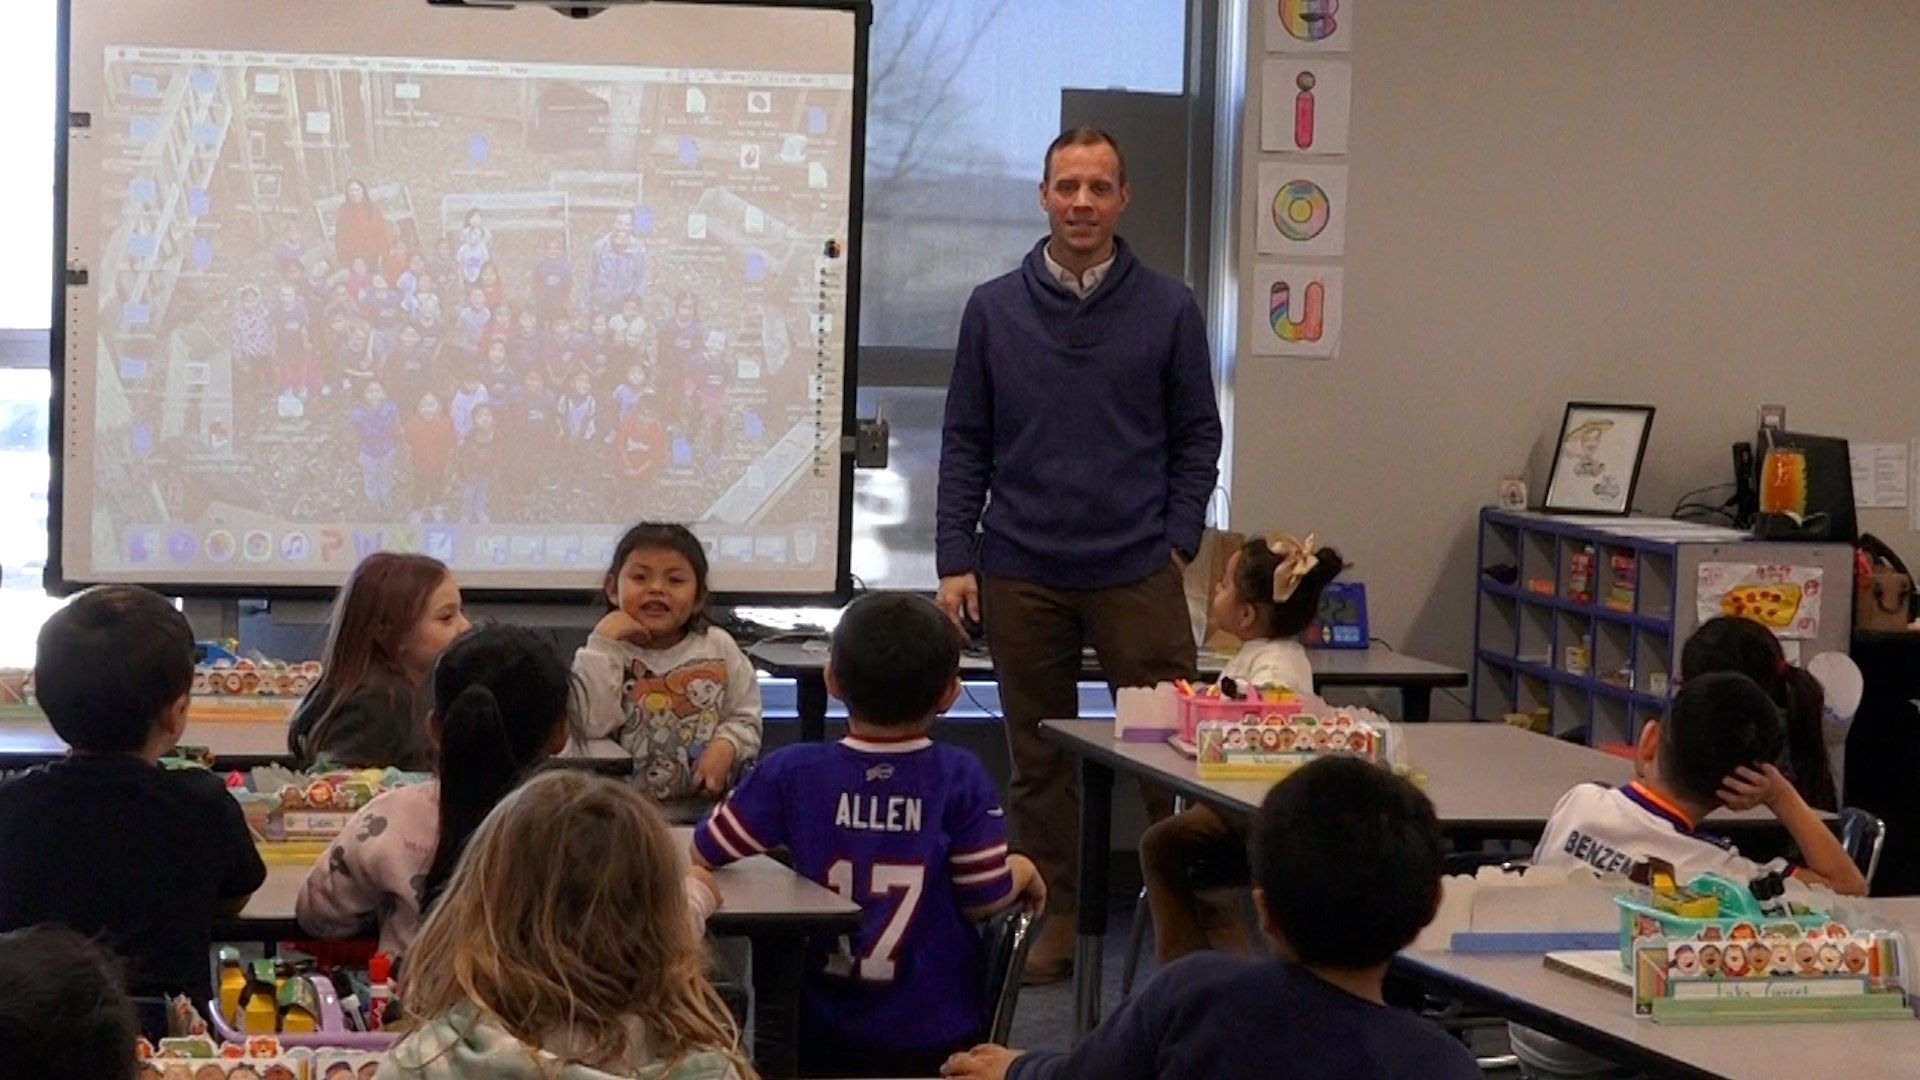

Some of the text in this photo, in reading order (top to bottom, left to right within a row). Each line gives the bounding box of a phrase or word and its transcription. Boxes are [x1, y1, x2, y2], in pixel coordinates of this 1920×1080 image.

[1294, 71, 1316, 150] i
[1269, 280, 1325, 343] u
[834, 792, 923, 832] ALLEN
[824, 858, 926, 981] 17
